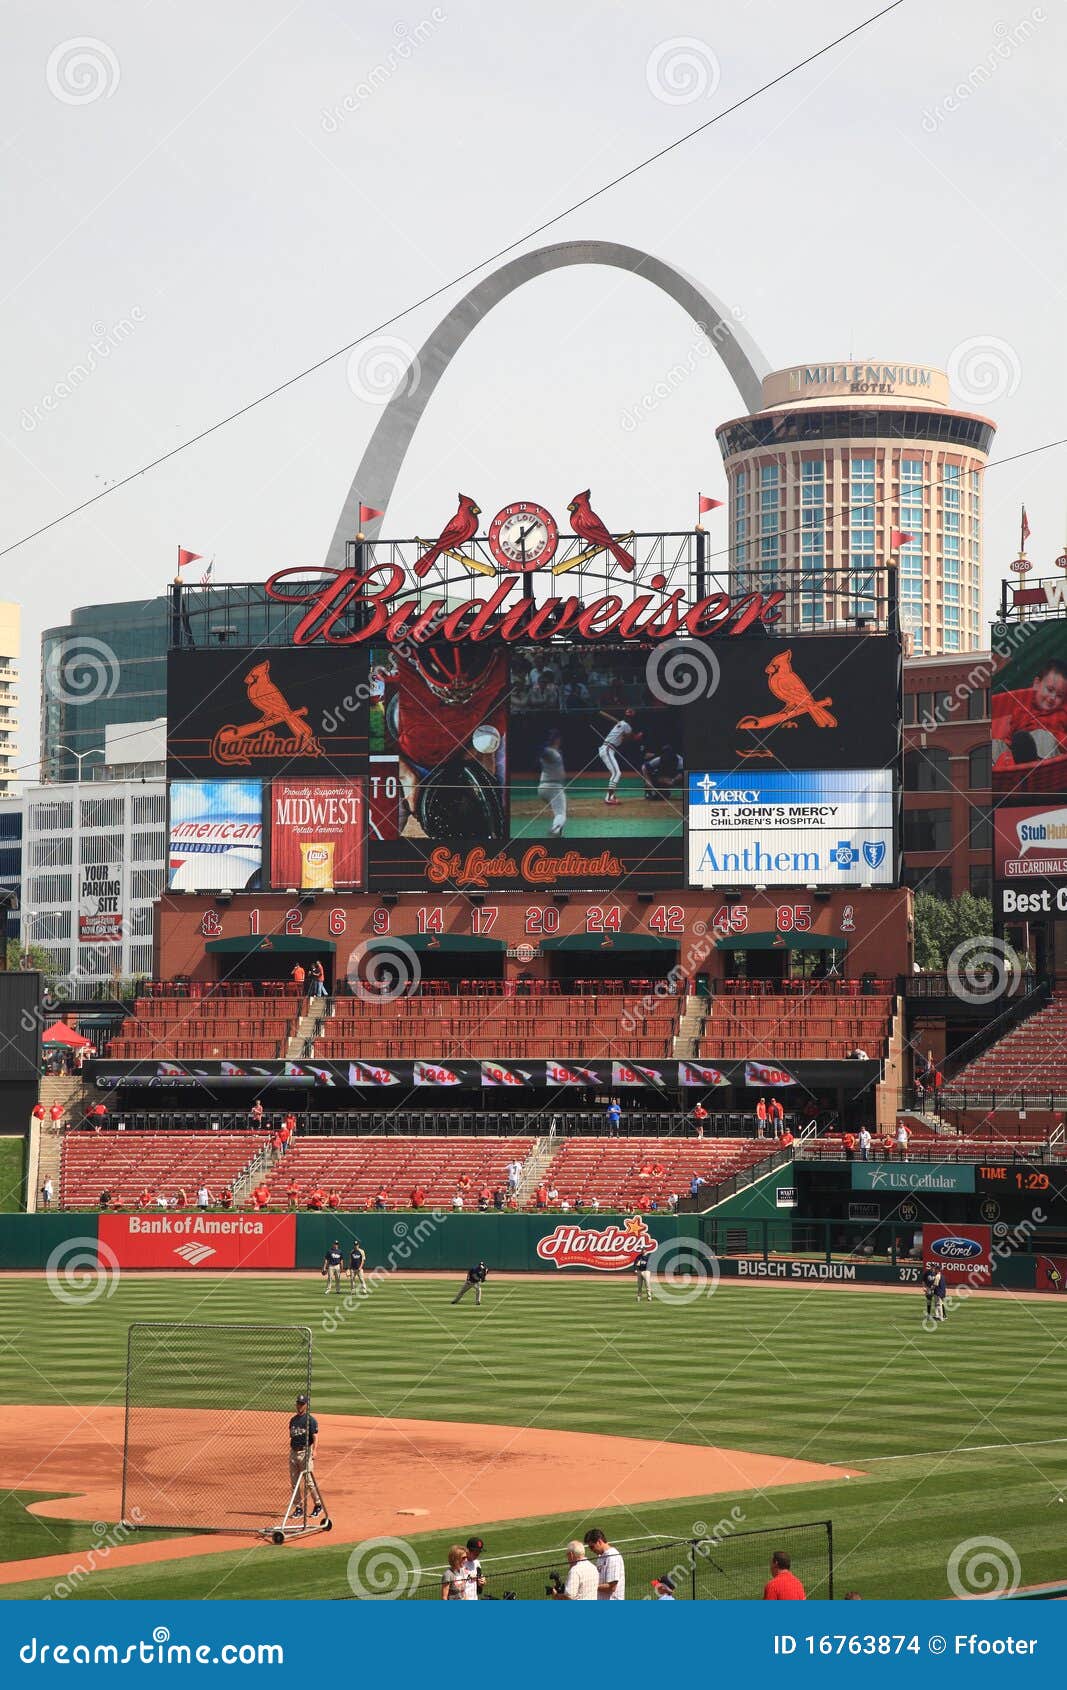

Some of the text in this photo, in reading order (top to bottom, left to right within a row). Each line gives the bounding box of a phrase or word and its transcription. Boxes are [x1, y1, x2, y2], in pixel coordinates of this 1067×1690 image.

[805, 366, 931, 386] MILLENNIUM
[851, 383, 895, 394] HOTEL
[502, 540, 546, 559] CARDNALS
[264, 563, 786, 645] Budweiser
[210, 724, 325, 765] Cardinals
[276, 798, 361, 825] MIDWEST
[711, 806, 838, 817] ST. JOHN'S MERCY
[170, 821, 263, 839] American
[711, 817, 825, 826] CHILDREN'S HOSPITAL
[521, 845, 622, 883] Cardinals
[696, 842, 822, 872] Anthem
[85, 865, 109, 881] YOUR
[82, 880, 121, 897] PARKING
[98, 897, 118, 912] SITE
[1003, 889, 1051, 912] Best
[250, 909, 260, 935] 1
[285, 908, 303, 935] 2
[329, 908, 347, 935] 6
[373, 908, 390, 935] 9
[417, 907, 443, 934] 14
[471, 907, 499, 934] 17
[526, 907, 560, 933] 20
[587, 906, 621, 933] 24
[650, 905, 685, 933] 42
[713, 905, 748, 933] 45
[776, 905, 812, 932] 85
[355, 1068, 391, 1082] 1942
[419, 1067, 457, 1082] 1944
[910, 1173, 956, 1188] Cellular
[980, 1167, 1049, 1189] TIME 1:29
[129, 1216, 263, 1234] Bank of America
[940, 1239, 972, 1257] Ford
[738, 1260, 856, 1280] BUSCH STADIUM
